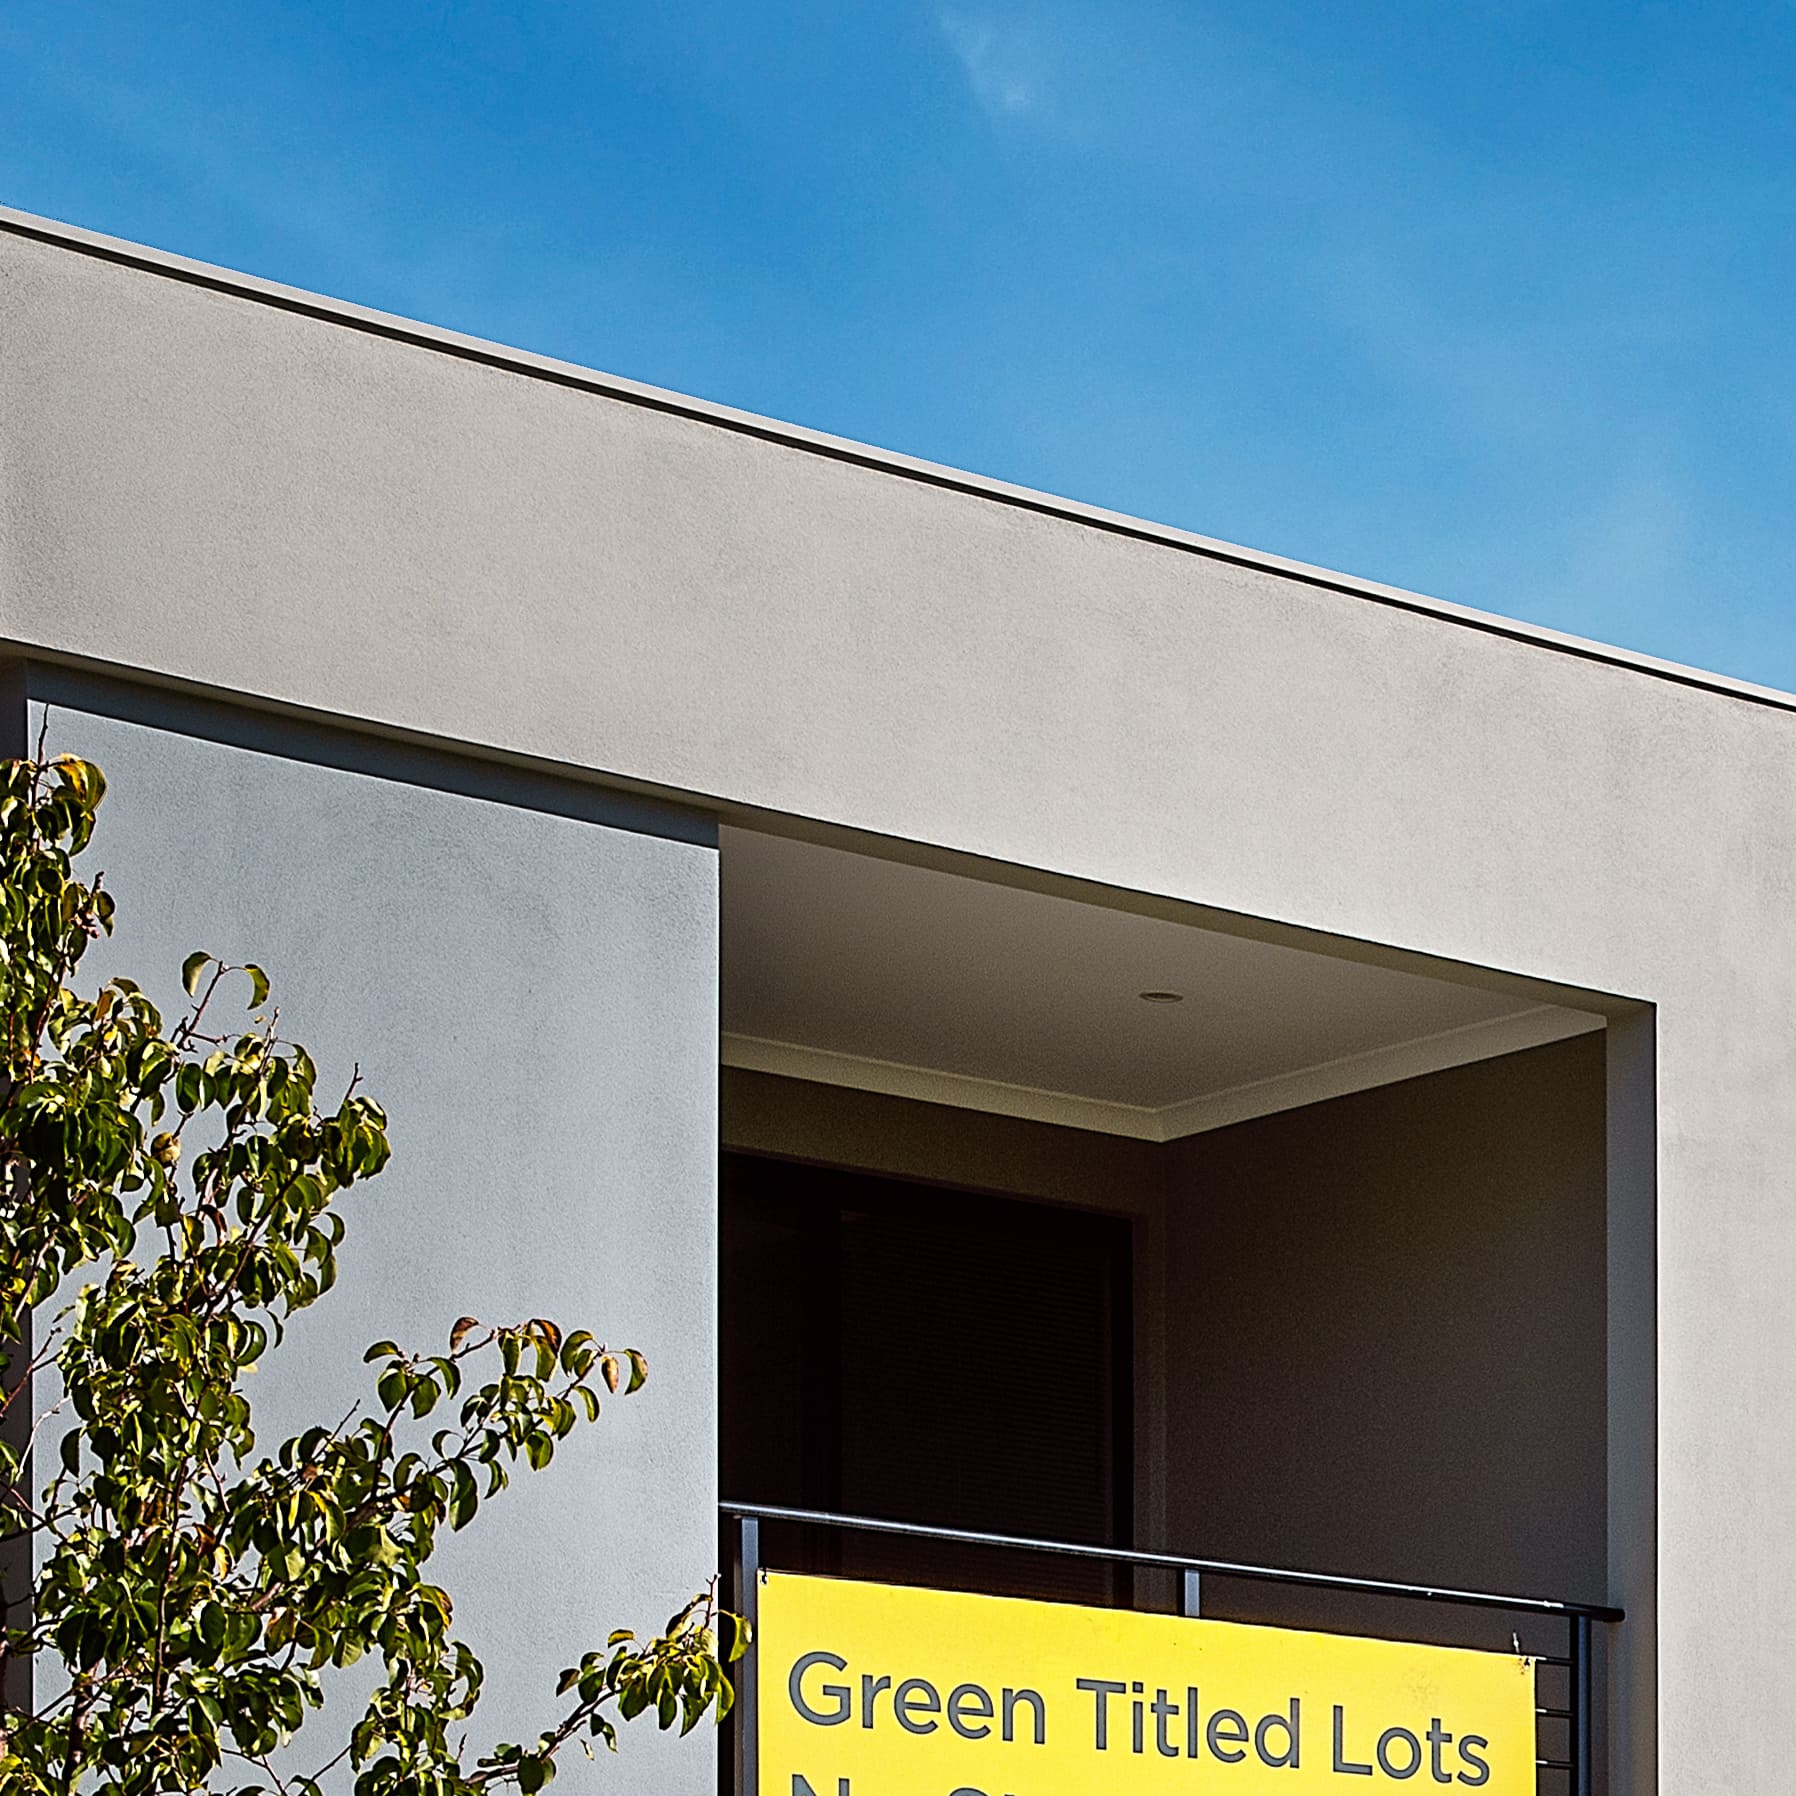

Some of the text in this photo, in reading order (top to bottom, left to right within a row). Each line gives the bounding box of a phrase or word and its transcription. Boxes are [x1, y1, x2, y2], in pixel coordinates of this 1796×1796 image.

[789, 1650, 1490, 1786] Green Titled Lots
